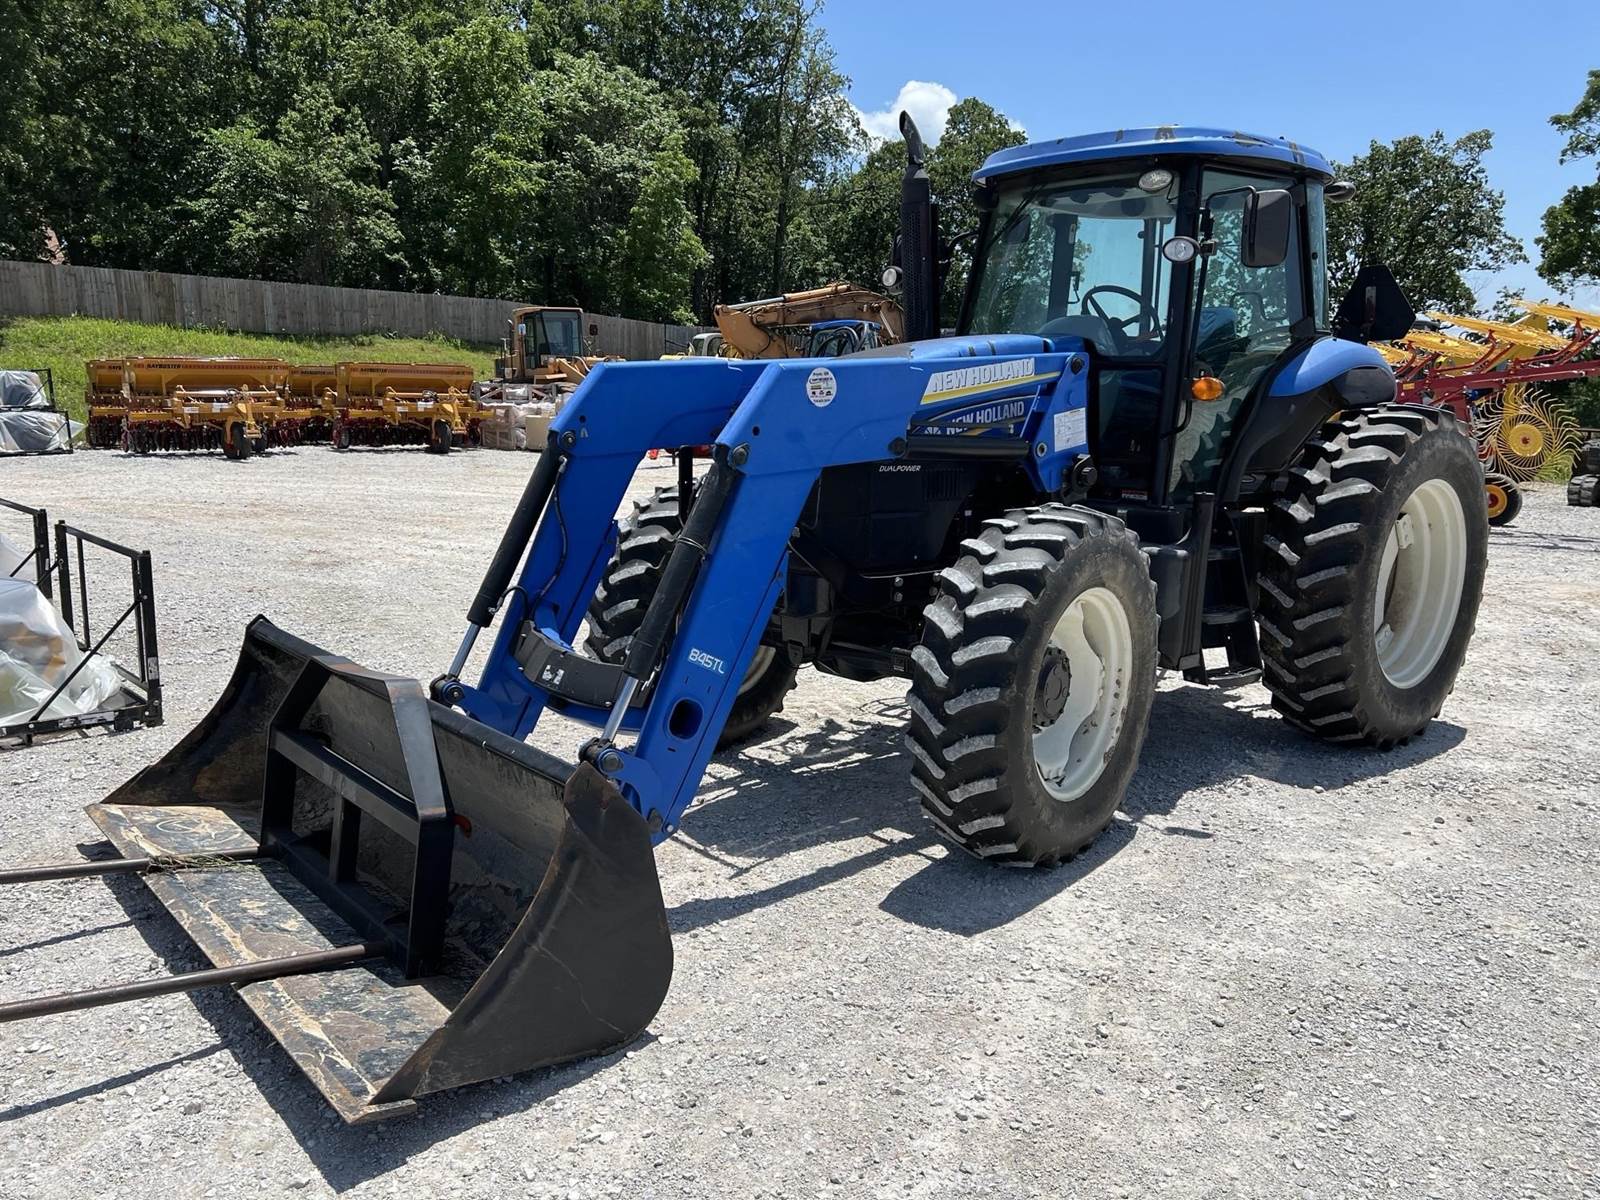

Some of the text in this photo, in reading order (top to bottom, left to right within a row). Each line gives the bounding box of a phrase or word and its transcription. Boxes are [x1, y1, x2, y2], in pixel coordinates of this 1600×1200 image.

[932, 358, 1035, 392] NEW HOLLAND
[976, 401, 1025, 424] HOLLAND
